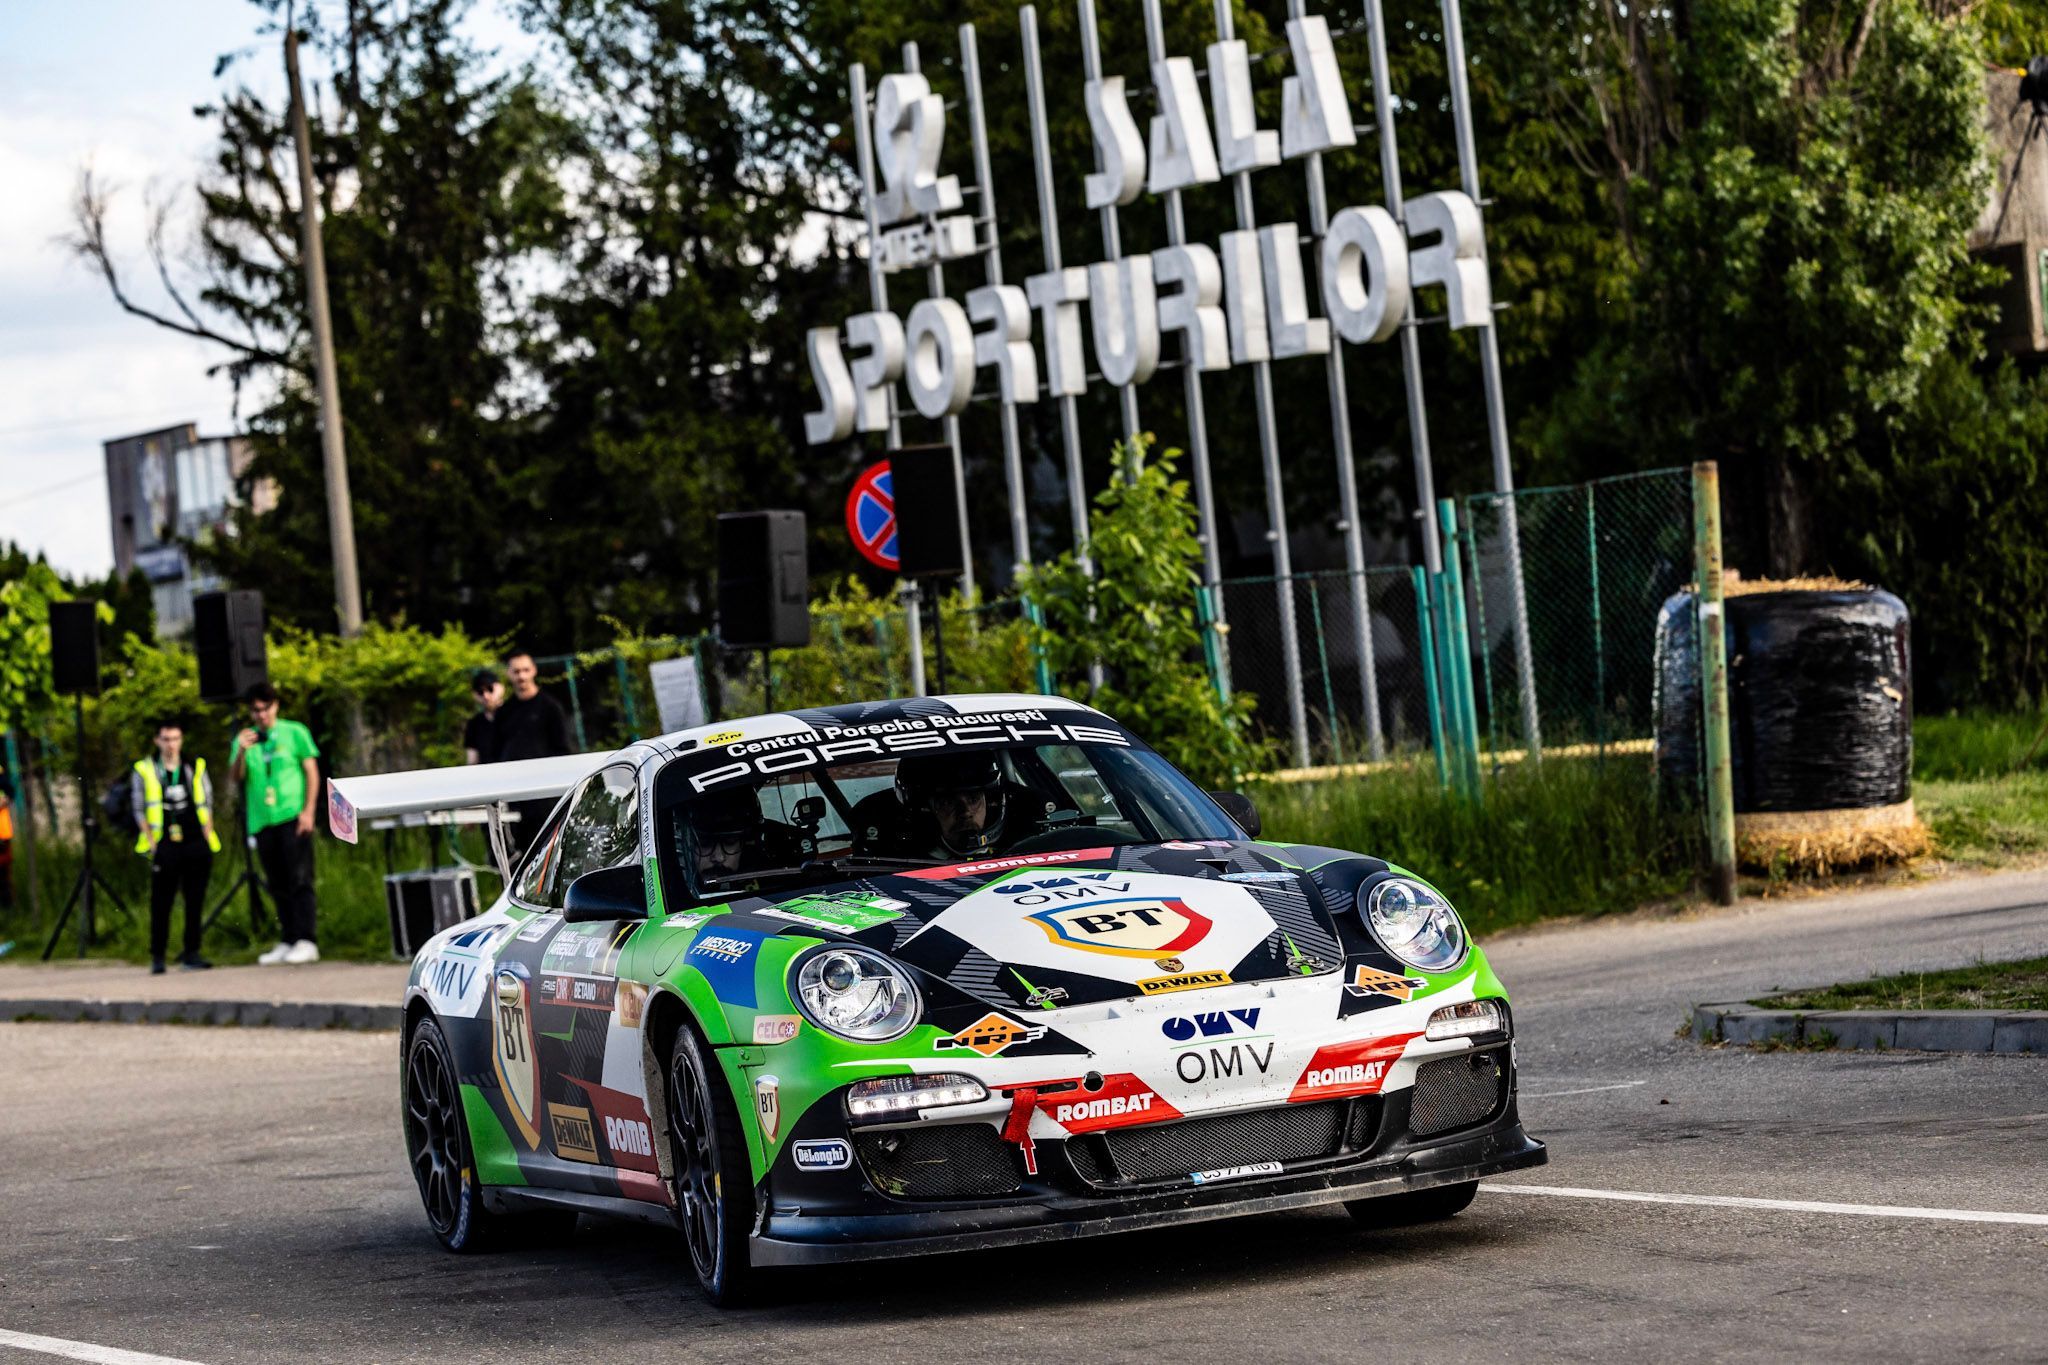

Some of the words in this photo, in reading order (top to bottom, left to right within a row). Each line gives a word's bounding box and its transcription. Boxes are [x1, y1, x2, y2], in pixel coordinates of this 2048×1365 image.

[1085, 15, 1357, 210] SALA
[803, 190, 1491, 446] SPORTURILOR
[727, 729, 822, 757] Centrul
[827, 718, 927, 741] Porsche
[930, 709, 1047, 729] București
[689, 725, 1131, 794] PORSCHE
[956, 852, 1080, 875] ROMBAT
[1013, 882, 1131, 906] OMV
[1068, 907, 1164, 936] BT
[500, 1006, 526, 1063] BT
[1176, 1042, 1275, 1083] OMV
[1307, 1060, 1386, 1088] ROMBAT
[760, 1092, 774, 1113] BT
[1056, 1092, 1154, 1123] ROMBAT
